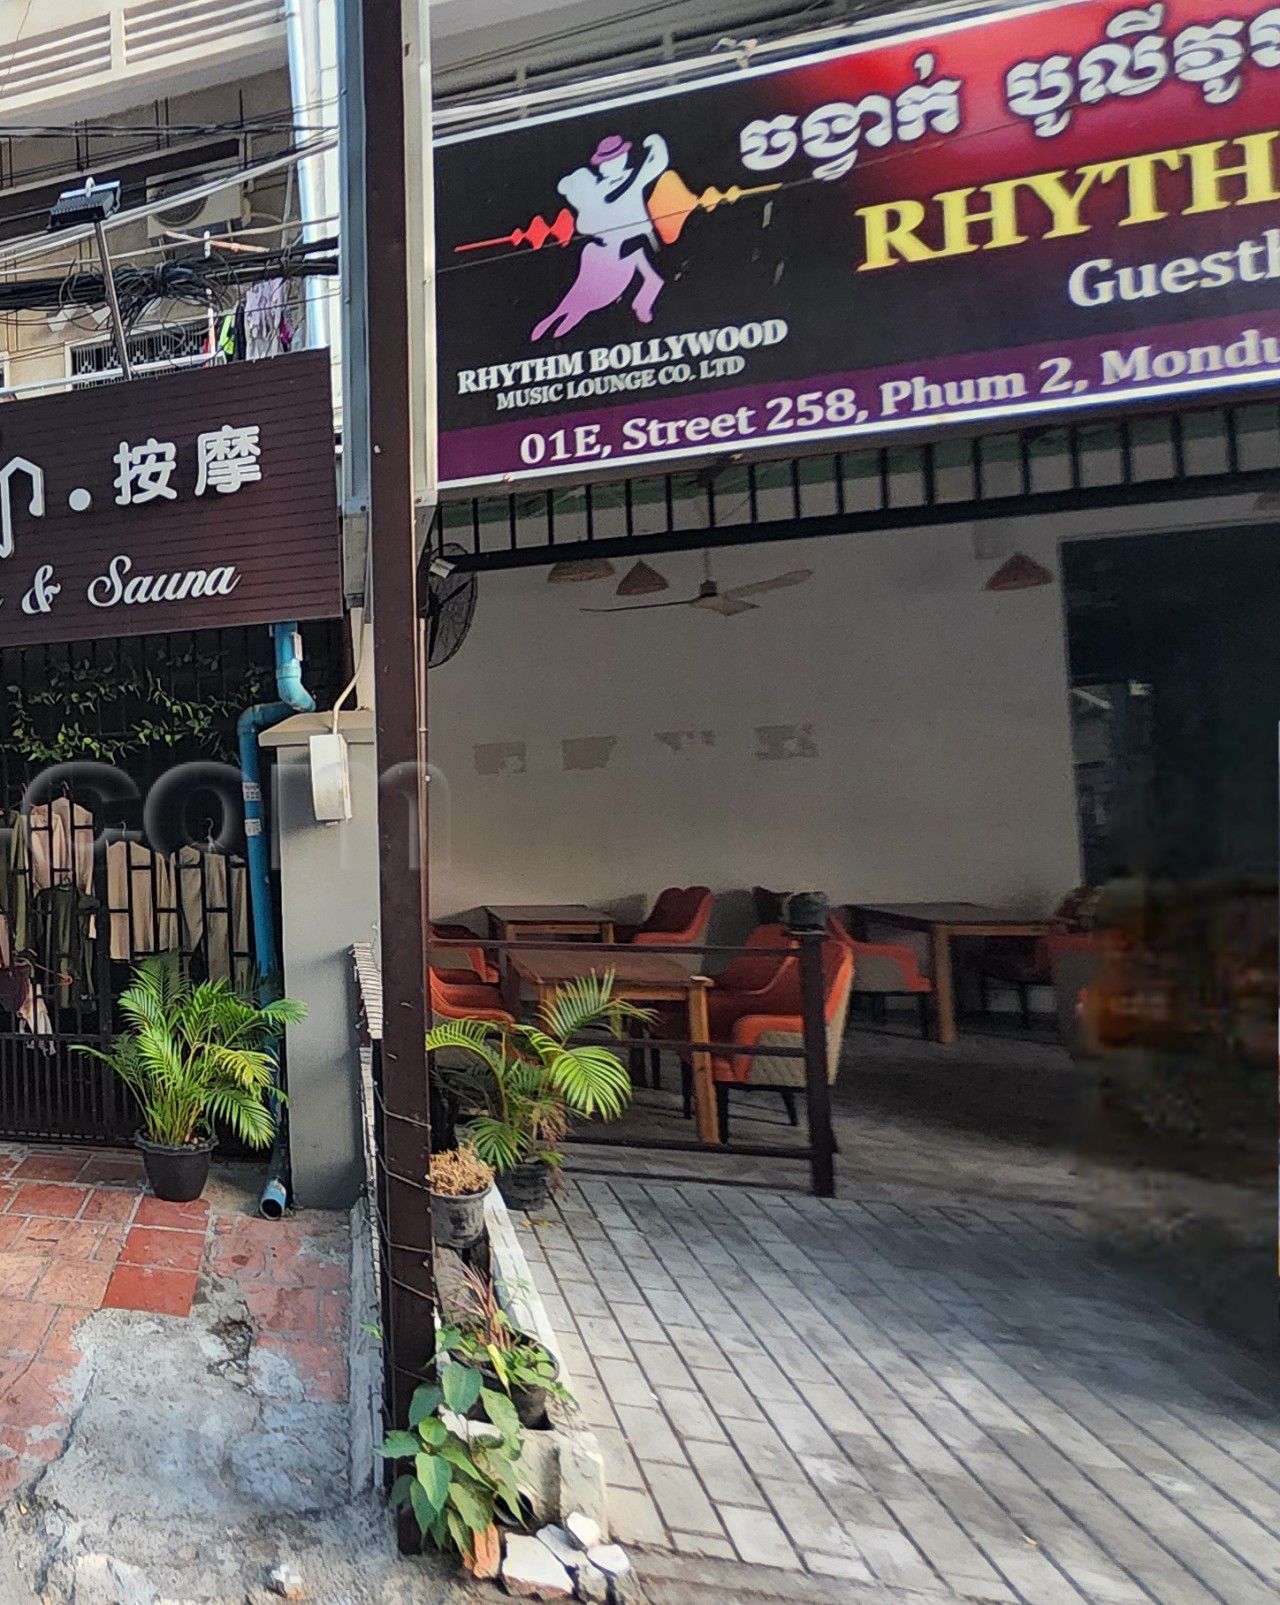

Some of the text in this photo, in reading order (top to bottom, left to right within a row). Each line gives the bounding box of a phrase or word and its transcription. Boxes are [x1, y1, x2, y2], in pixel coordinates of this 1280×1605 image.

[854, 130, 1280, 271] RHYTH
[457, 319, 788, 395] RHYTHM BOLLYWOOD
[496, 355, 746, 411] MUSIC LOUNGE CO. LTD
[520, 424, 612, 465] 01E,
[622, 405, 757, 451] Street
[765, 388, 869, 432] 258,
[878, 371, 1027, 418] Phum
[1038, 357, 1089, 396] 2,
[113, 425, 262, 505] 按摩
[21, 564, 62, 615] &
[86, 555, 242, 608] Sauna
